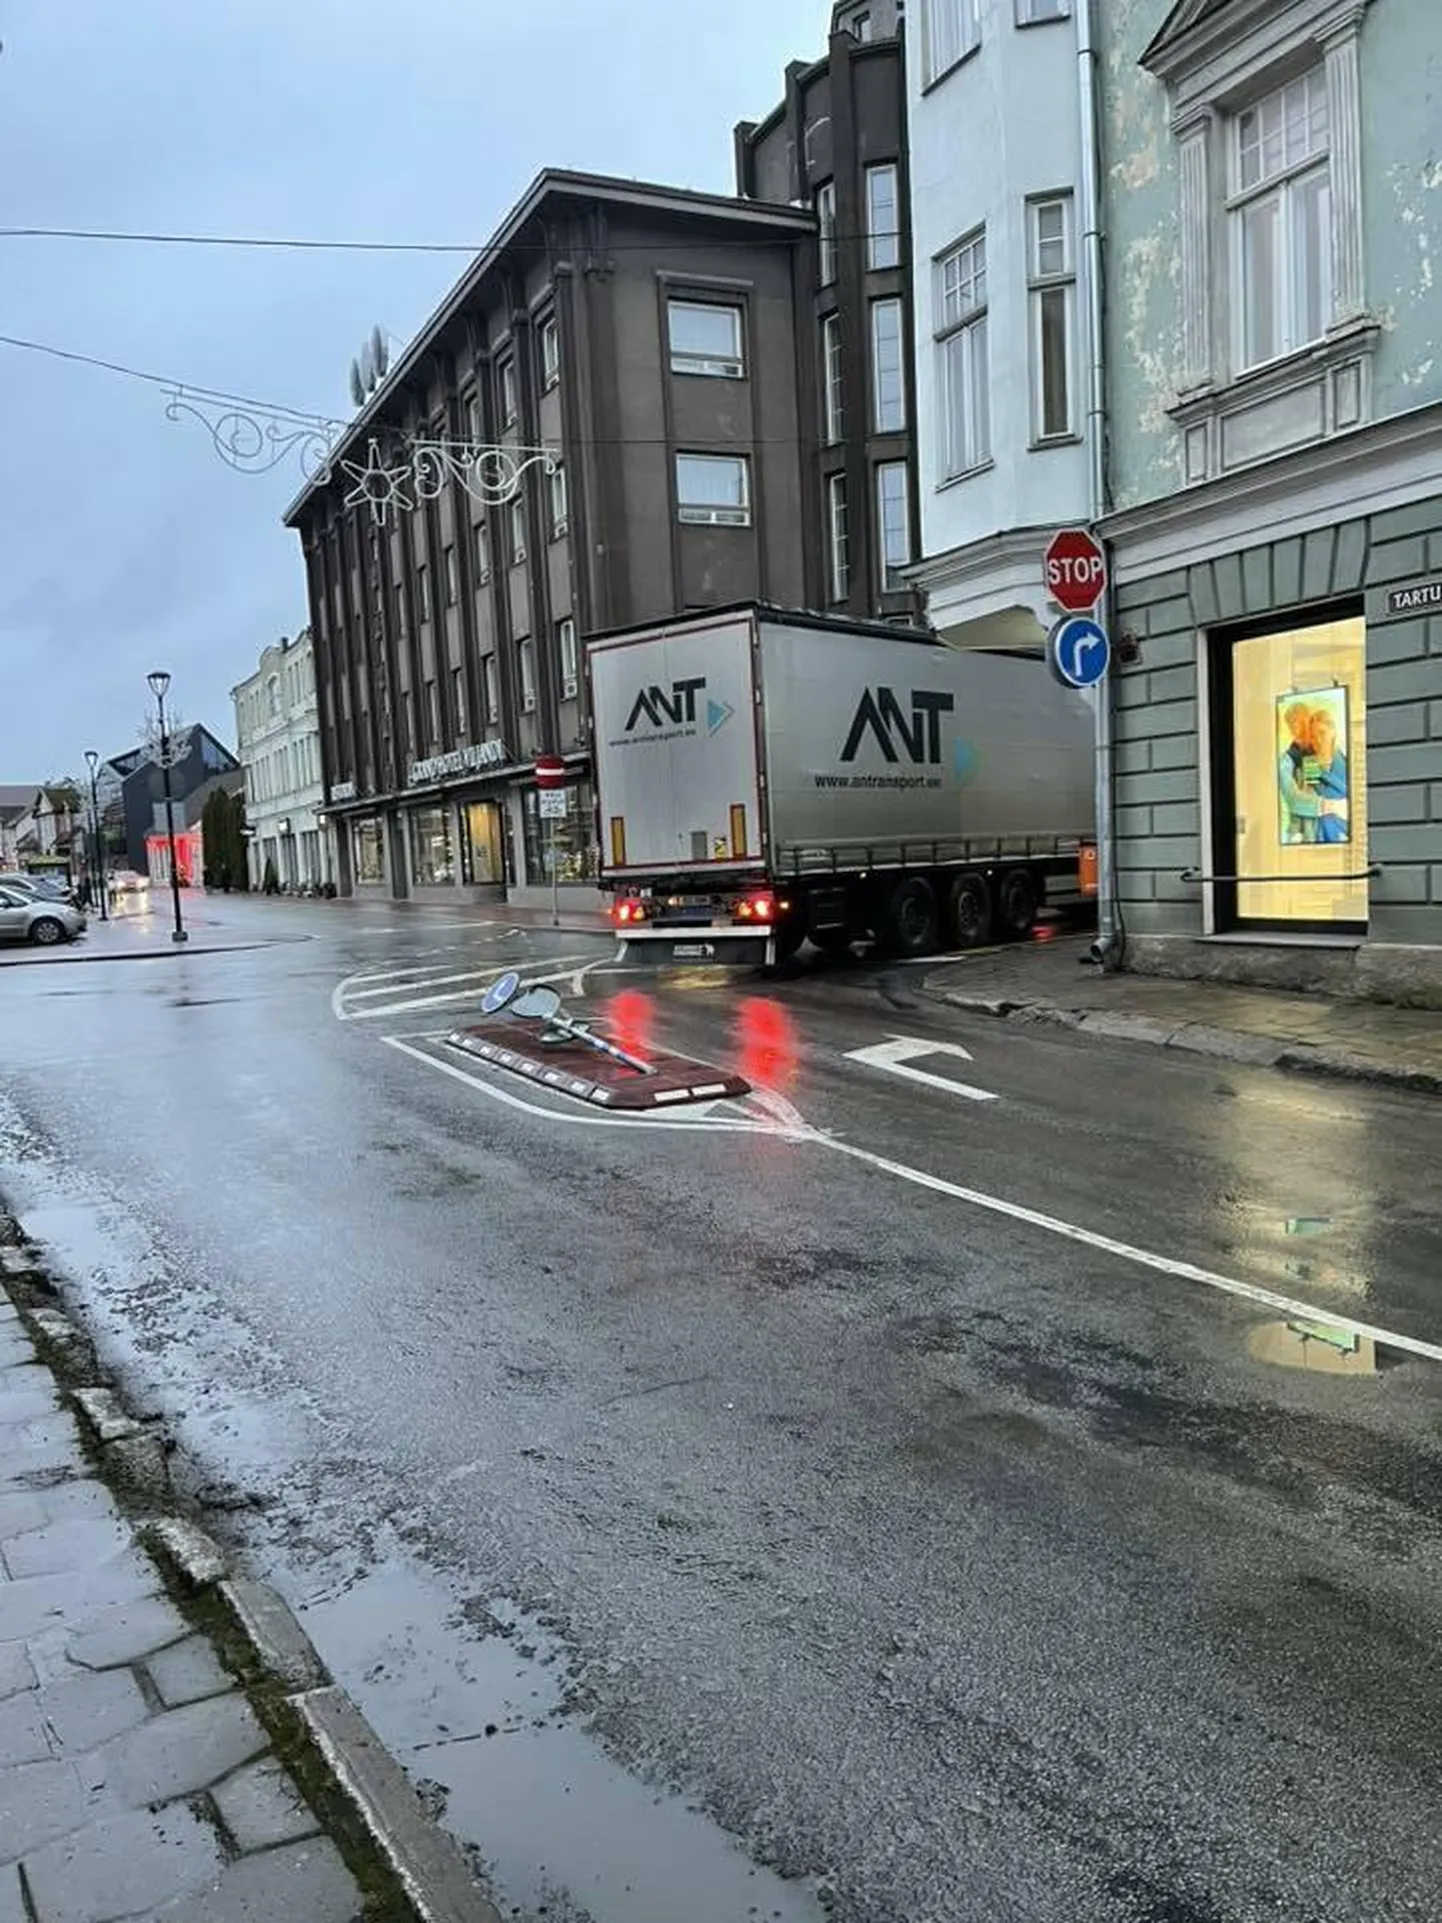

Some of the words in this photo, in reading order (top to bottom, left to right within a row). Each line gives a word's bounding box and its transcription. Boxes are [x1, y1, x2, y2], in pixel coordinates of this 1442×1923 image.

[1048, 556, 1103, 585] STOP
[1393, 585, 1441, 609] TARTU
[624, 677, 706, 731] ANT
[839, 686, 954, 764] ANT
[814, 774, 943, 791] www.antransport.ee
